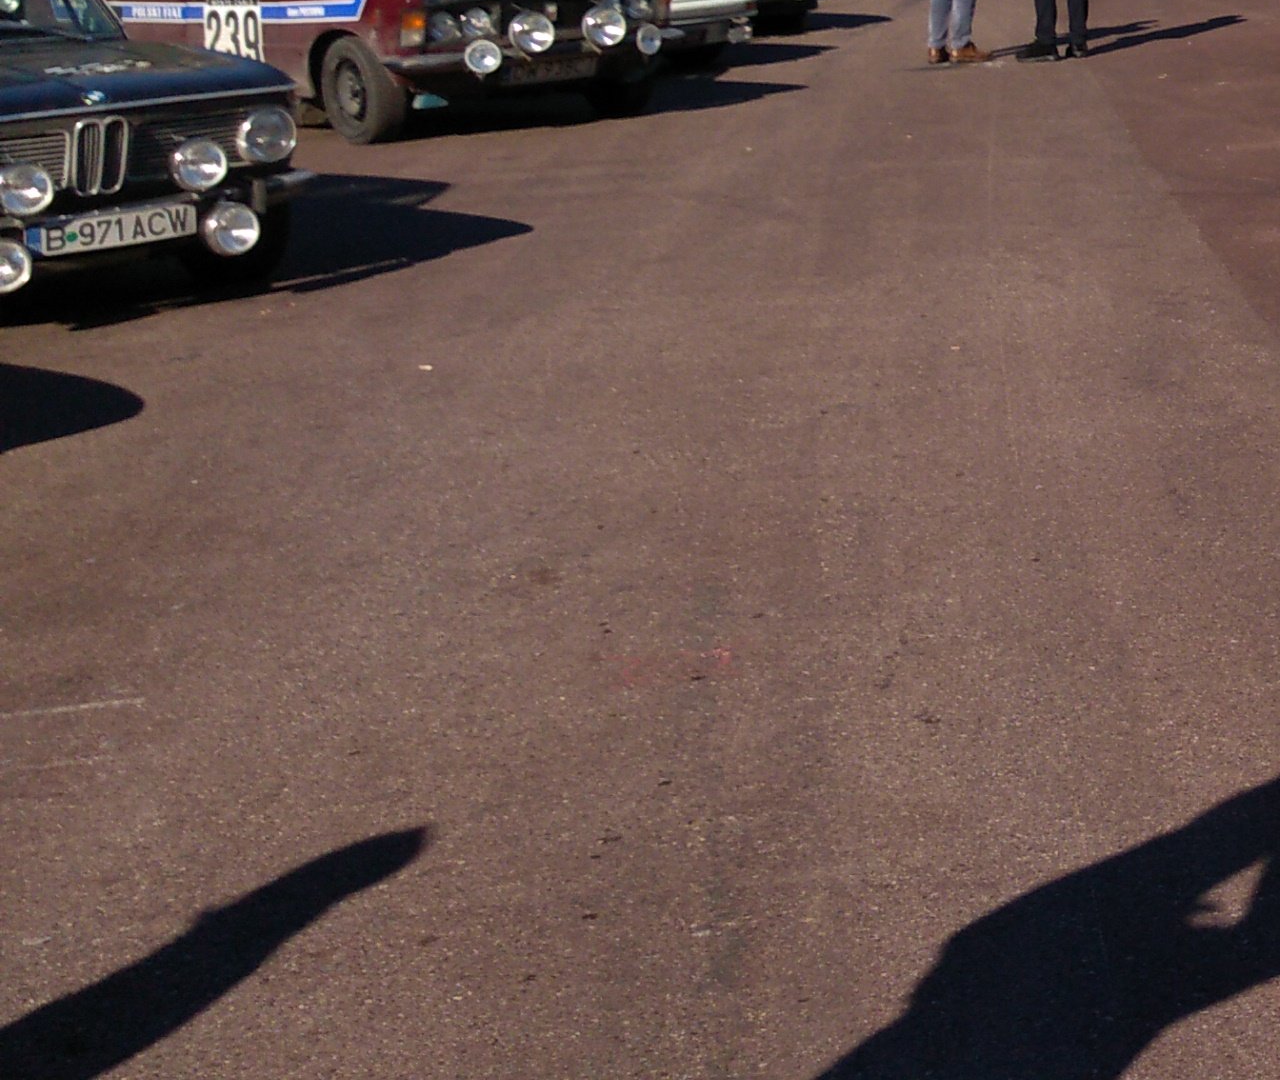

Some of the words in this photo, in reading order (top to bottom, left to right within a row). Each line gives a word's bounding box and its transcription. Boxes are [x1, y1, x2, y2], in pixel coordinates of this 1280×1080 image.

[206, 9, 261, 62] 239
[46, 227, 66, 252] B
[78, 217, 125, 246] 971
[132, 207, 188, 240] ACW
